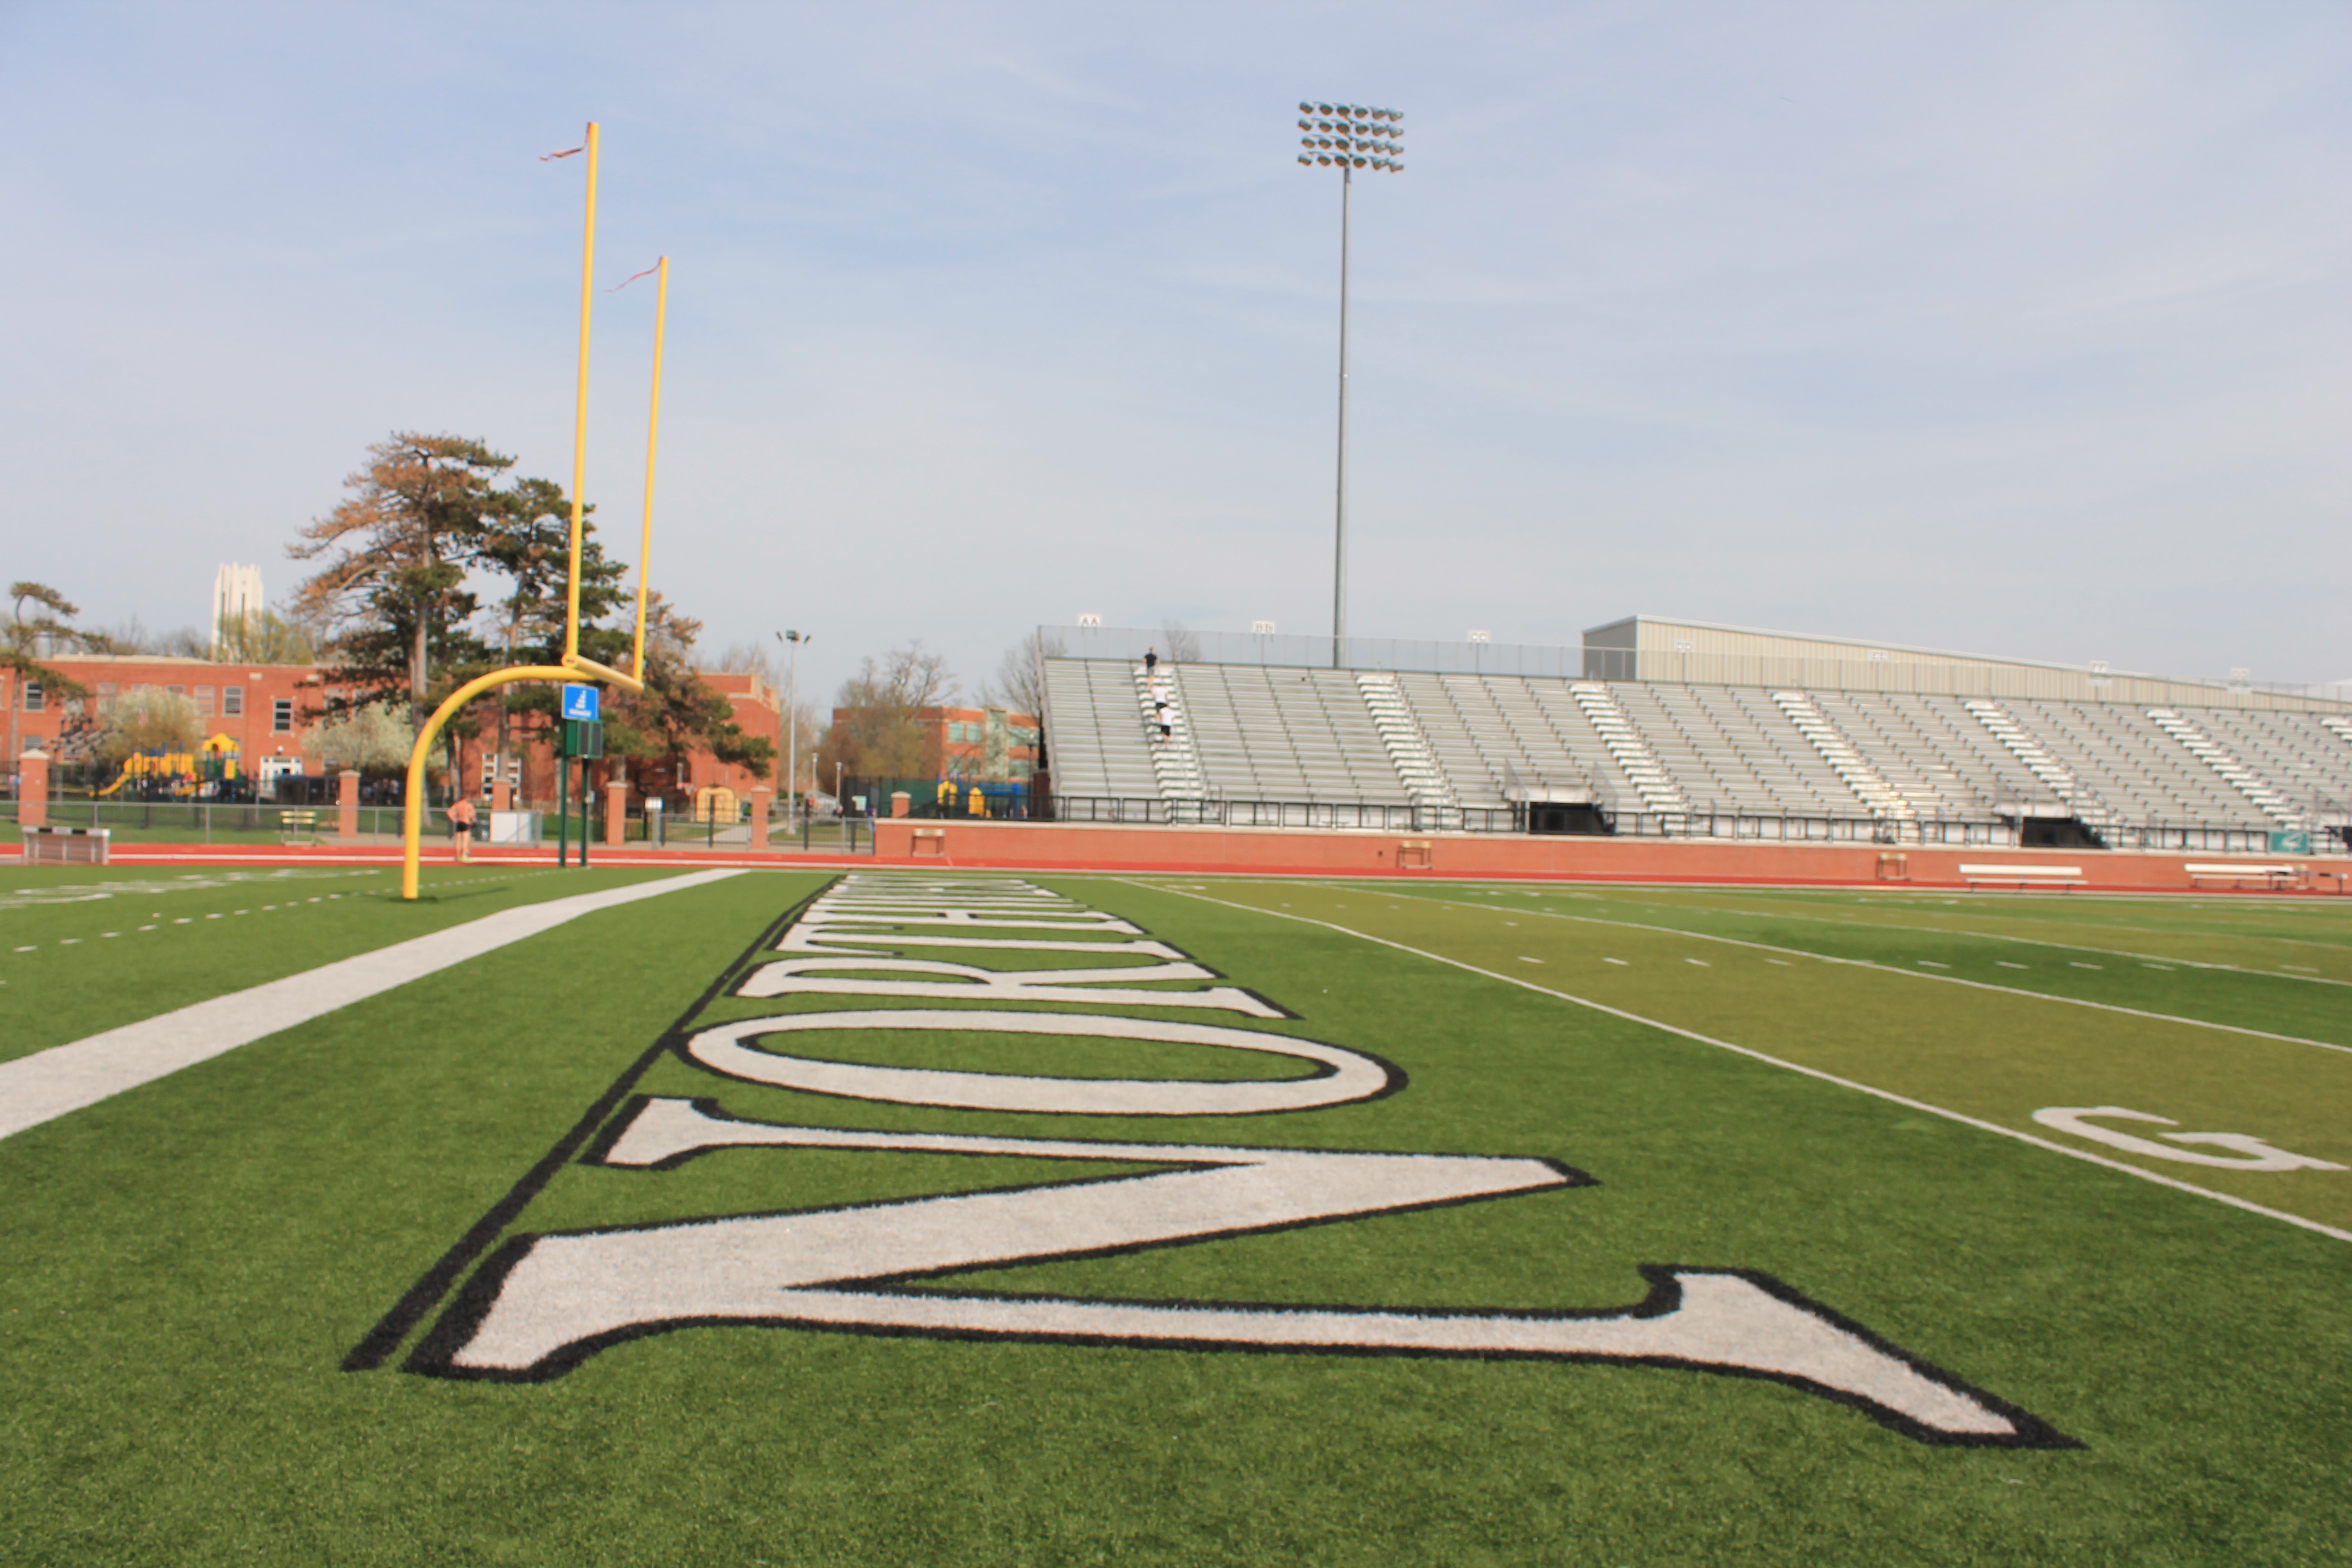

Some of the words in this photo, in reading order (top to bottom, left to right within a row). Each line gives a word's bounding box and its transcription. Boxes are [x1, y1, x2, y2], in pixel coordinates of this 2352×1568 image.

[1082, 617, 1099, 627] AA
[410, 875, 2087, 1448] NORTHWEST
[2031, 1106, 2351, 1172] G
